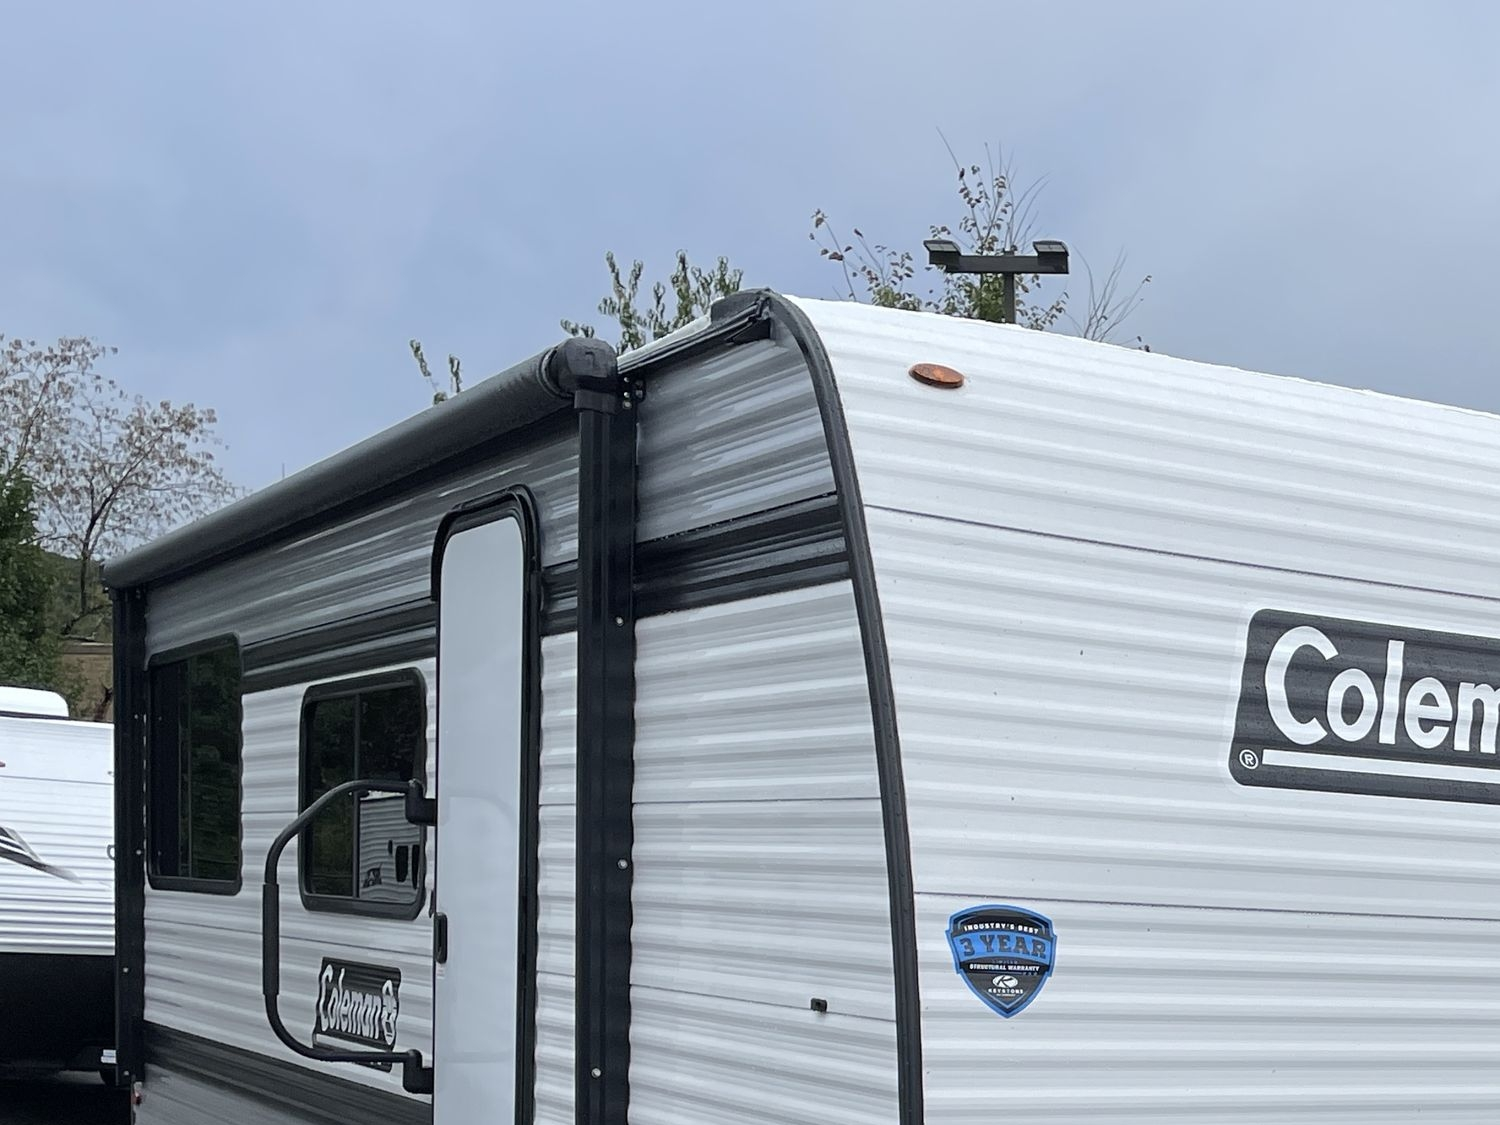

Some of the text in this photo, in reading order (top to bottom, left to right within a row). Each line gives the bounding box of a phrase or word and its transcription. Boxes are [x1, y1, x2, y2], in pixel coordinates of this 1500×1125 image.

[964, 922, 1039, 935] INDUSTRY'S BEST
[960, 934, 1047, 960] 3 YEAR
[1007, 964, 1040, 972] WARRANTY
[320, 964, 382, 1040] Coleman
